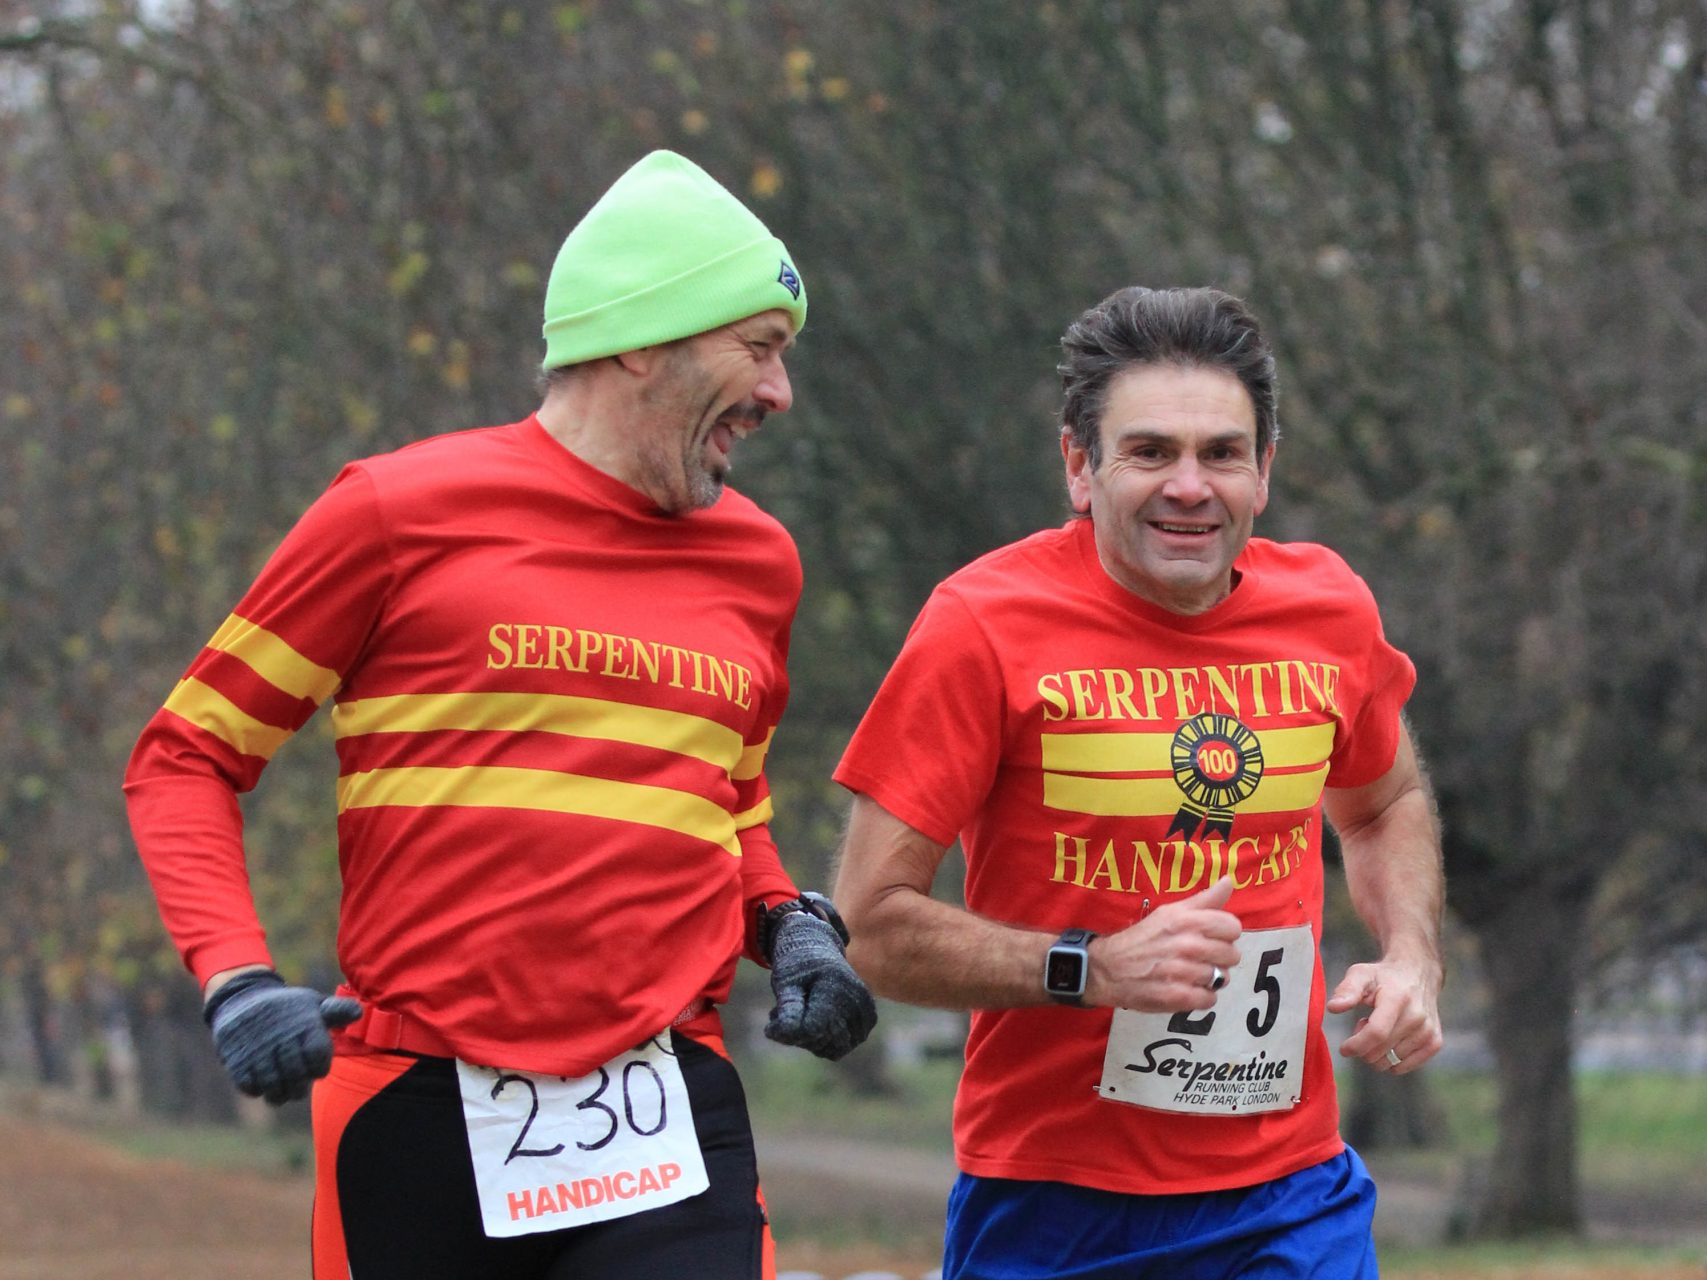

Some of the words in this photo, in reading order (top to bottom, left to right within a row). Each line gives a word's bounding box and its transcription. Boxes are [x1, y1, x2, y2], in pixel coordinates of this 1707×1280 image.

[486, 623, 753, 711] SERPENTINE
[1037, 660, 1344, 722] SERPENTINE
[1198, 749, 1238, 775] 100
[1124, 1037, 1288, 1092] Serpentine
[1194, 1081, 1245, 1093] RUNNING
[1247, 1081, 1270, 1093] CLUB
[490, 1060, 668, 1166] 230
[1174, 1093, 1207, 1105] HYDE
[1210, 1095, 1239, 1106] PARK
[1242, 1093, 1280, 1105] LONDON
[507, 1163, 682, 1220] HANDICAP
